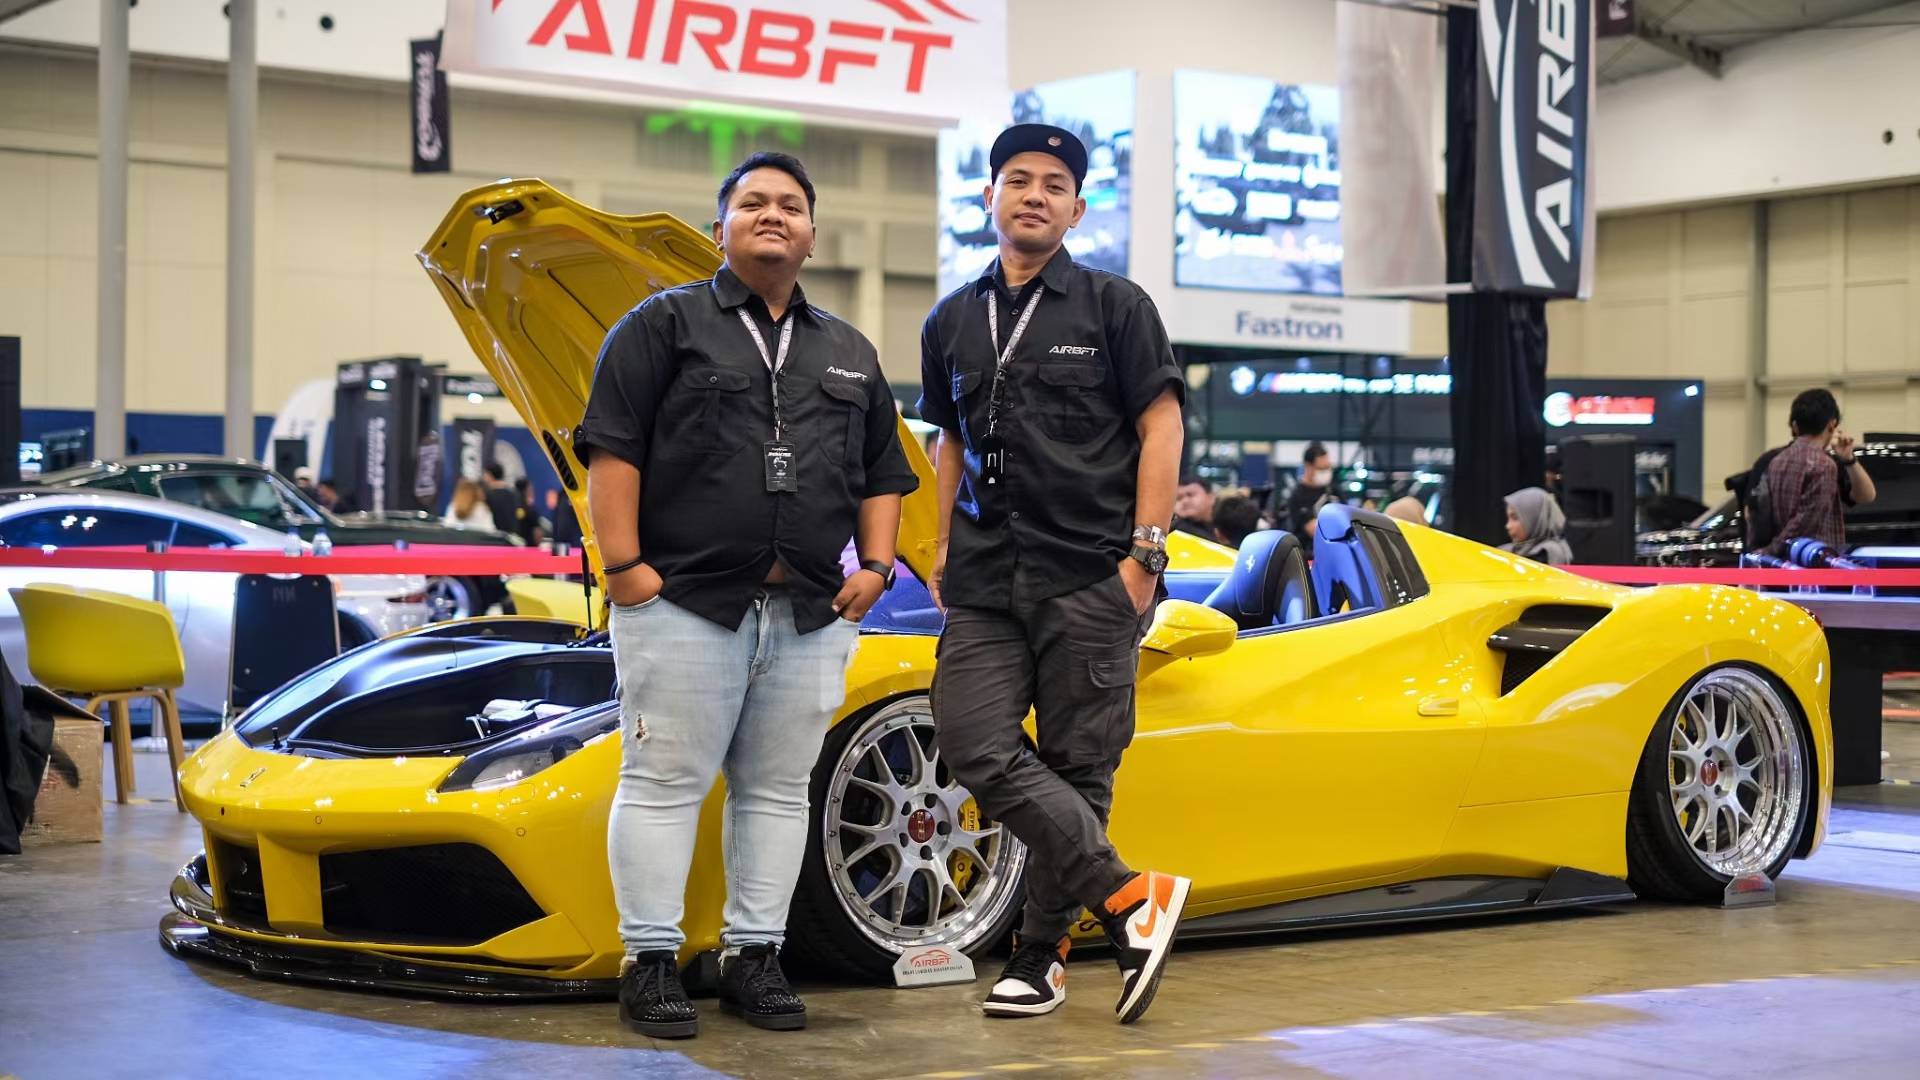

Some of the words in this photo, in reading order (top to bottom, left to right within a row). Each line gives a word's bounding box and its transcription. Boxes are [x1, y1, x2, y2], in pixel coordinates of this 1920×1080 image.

[527, 0, 953, 93] AIRBFT
[1235, 310, 1344, 340] Fastron
[1048, 345, 1099, 357] AIRBFT
[826, 365, 868, 381] AIRBFT
[914, 957, 952, 968] AIRBFT
